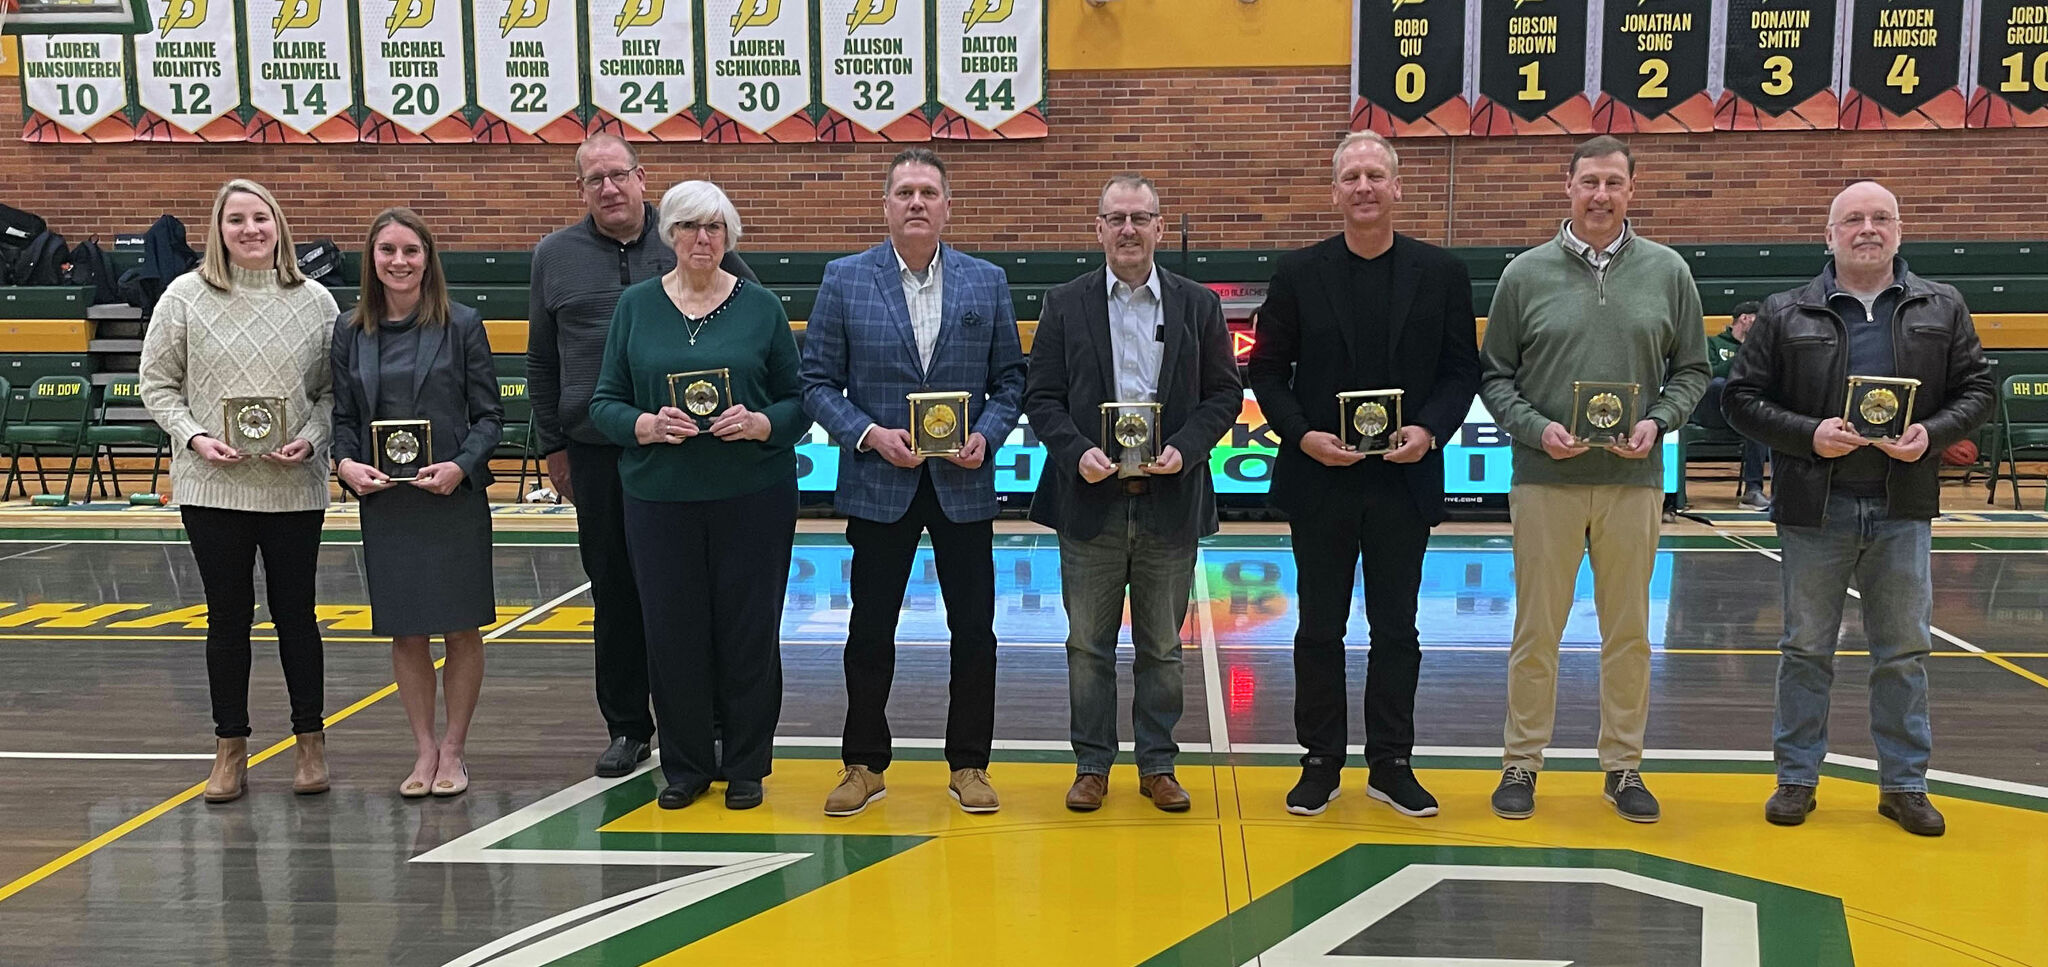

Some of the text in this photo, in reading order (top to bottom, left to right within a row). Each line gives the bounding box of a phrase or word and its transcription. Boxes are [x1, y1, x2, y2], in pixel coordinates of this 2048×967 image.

[1510, 17, 1556, 34] GIBSON
[1623, 14, 1691, 32] JONATHAN
[1752, 11, 1809, 28] DONAVIN
[1880, 9, 1933, 27] KAYDEN
[1395, 19, 1428, 36] BOBO
[2008, 26, 2048, 44] GROUL
[962, 36, 1016, 53] DALTON
[1509, 36, 1556, 54] BROWN
[1640, 34, 1672, 51] SONG
[1761, 30, 1800, 48] SMITH
[1874, 29, 1937, 46] HANDSOR
[46, 43, 100, 58] LAUREN
[156, 42, 216, 57] MELANIE
[273, 42, 326, 58] KLAIRE
[381, 42, 445, 57] RACHAEL
[510, 42, 544, 57] JANA
[622, 40, 660, 56] RILEY
[730, 40, 784, 56] LAUREN
[844, 38, 902, 55] ALLISON
[1401, 39, 1421, 56] QIU
[27, 62, 120, 78] VANSUMEREN
[153, 61, 221, 77] KOLNITYS
[262, 63, 340, 80] CALDWELL
[390, 61, 438, 77] IEUTER
[506, 61, 549, 77] MOHR
[600, 59, 684, 75] SCHIKORRA
[716, 60, 801, 76] SCHIKORRA
[835, 58, 912, 75] STOCKTON
[962, 56, 1017, 73] DEBOER
[1518, 61, 1545, 100] 1
[1638, 59, 1668, 98] 2
[1762, 56, 1793, 95] 3
[1887, 55, 1919, 93] 4
[1396, 64, 1425, 102] 0
[57, 84, 98, 115] 10
[170, 83, 211, 114] 12
[282, 83, 326, 114] 14
[392, 83, 439, 115] 20
[511, 83, 547, 112] 22
[620, 82, 668, 113] 24
[739, 82, 779, 111] 30
[853, 81, 894, 110] 32
[965, 79, 1015, 111] 44
[38, 384, 80, 395] HH DOW
[114, 384, 130, 395] HH
[501, 384, 525, 396] DOW
[2013, 383, 2030, 394] HH
